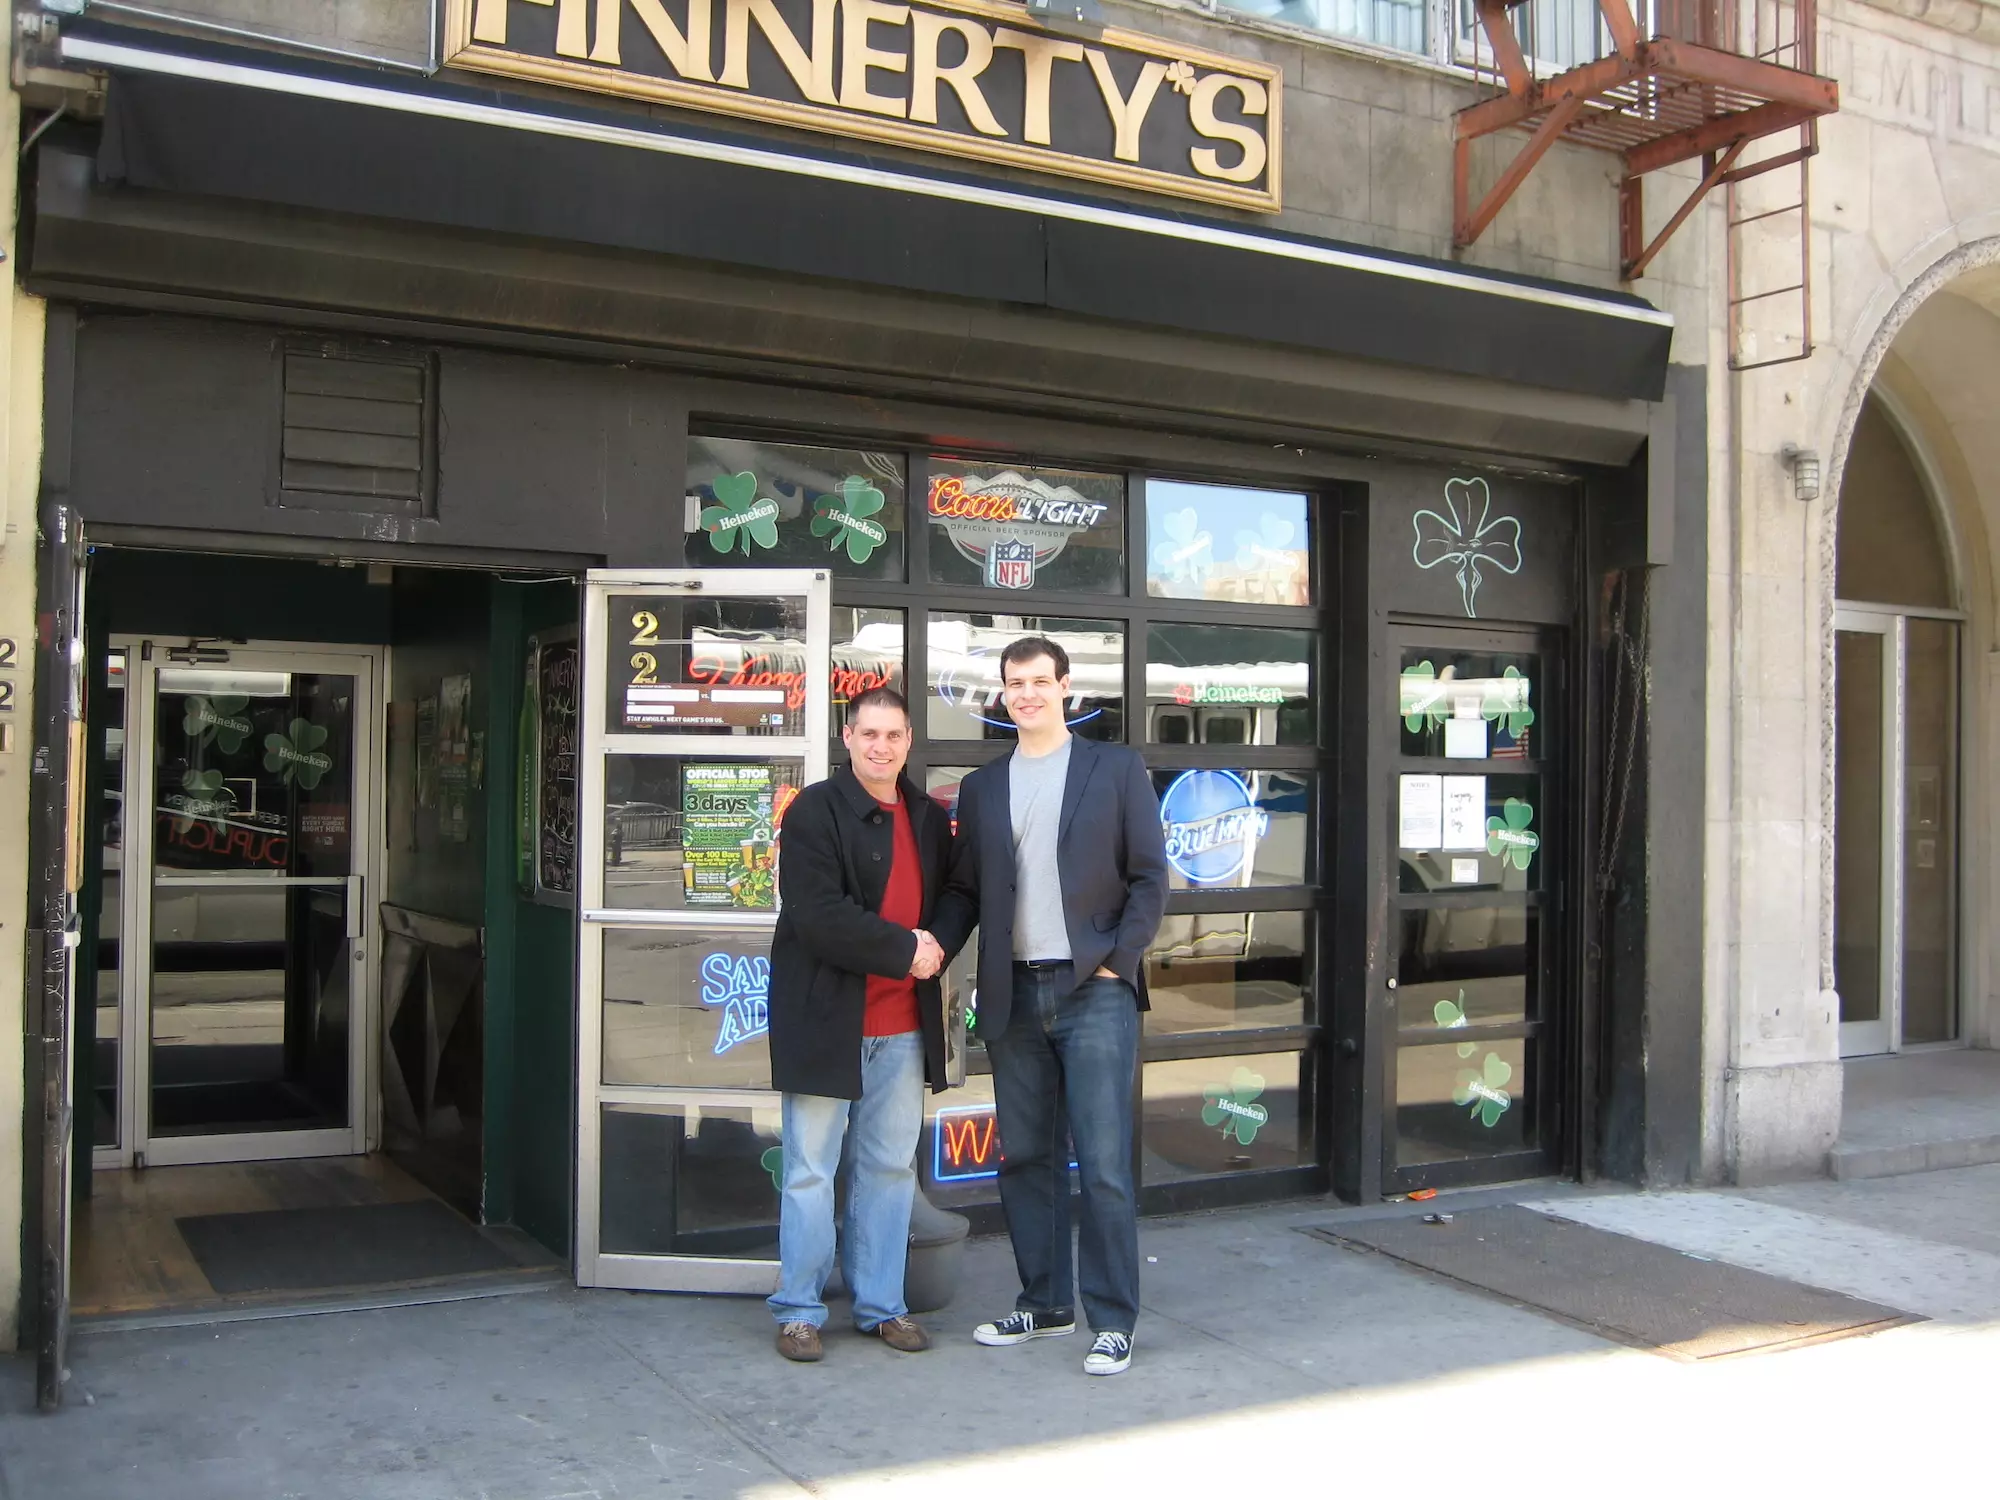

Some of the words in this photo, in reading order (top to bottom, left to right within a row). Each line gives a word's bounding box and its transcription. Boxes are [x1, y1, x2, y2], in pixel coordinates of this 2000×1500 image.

[931, 477, 1015, 520] Coors
[1016, 499, 1108, 527] LIGHT
[719, 503, 776, 531] Heineken
[828, 509, 883, 541] Heineken
[951, 523, 992, 533] OFFICIAL
[996, 527, 1021, 535] BEER
[1023, 528, 1066, 538] SPONSOR
[998, 562, 1030, 588] NFL
[1193, 682, 1284, 704] Heineken
[199, 710, 250, 733] Heineken
[278, 747, 329, 769] Heineken
[686, 769, 737, 779] OFFICIAL
[686, 794, 700, 811] 3
[701, 793, 749, 814] days
[1497, 829, 1537, 847] Heineken
[1218, 1098, 1264, 1121] Heineken
